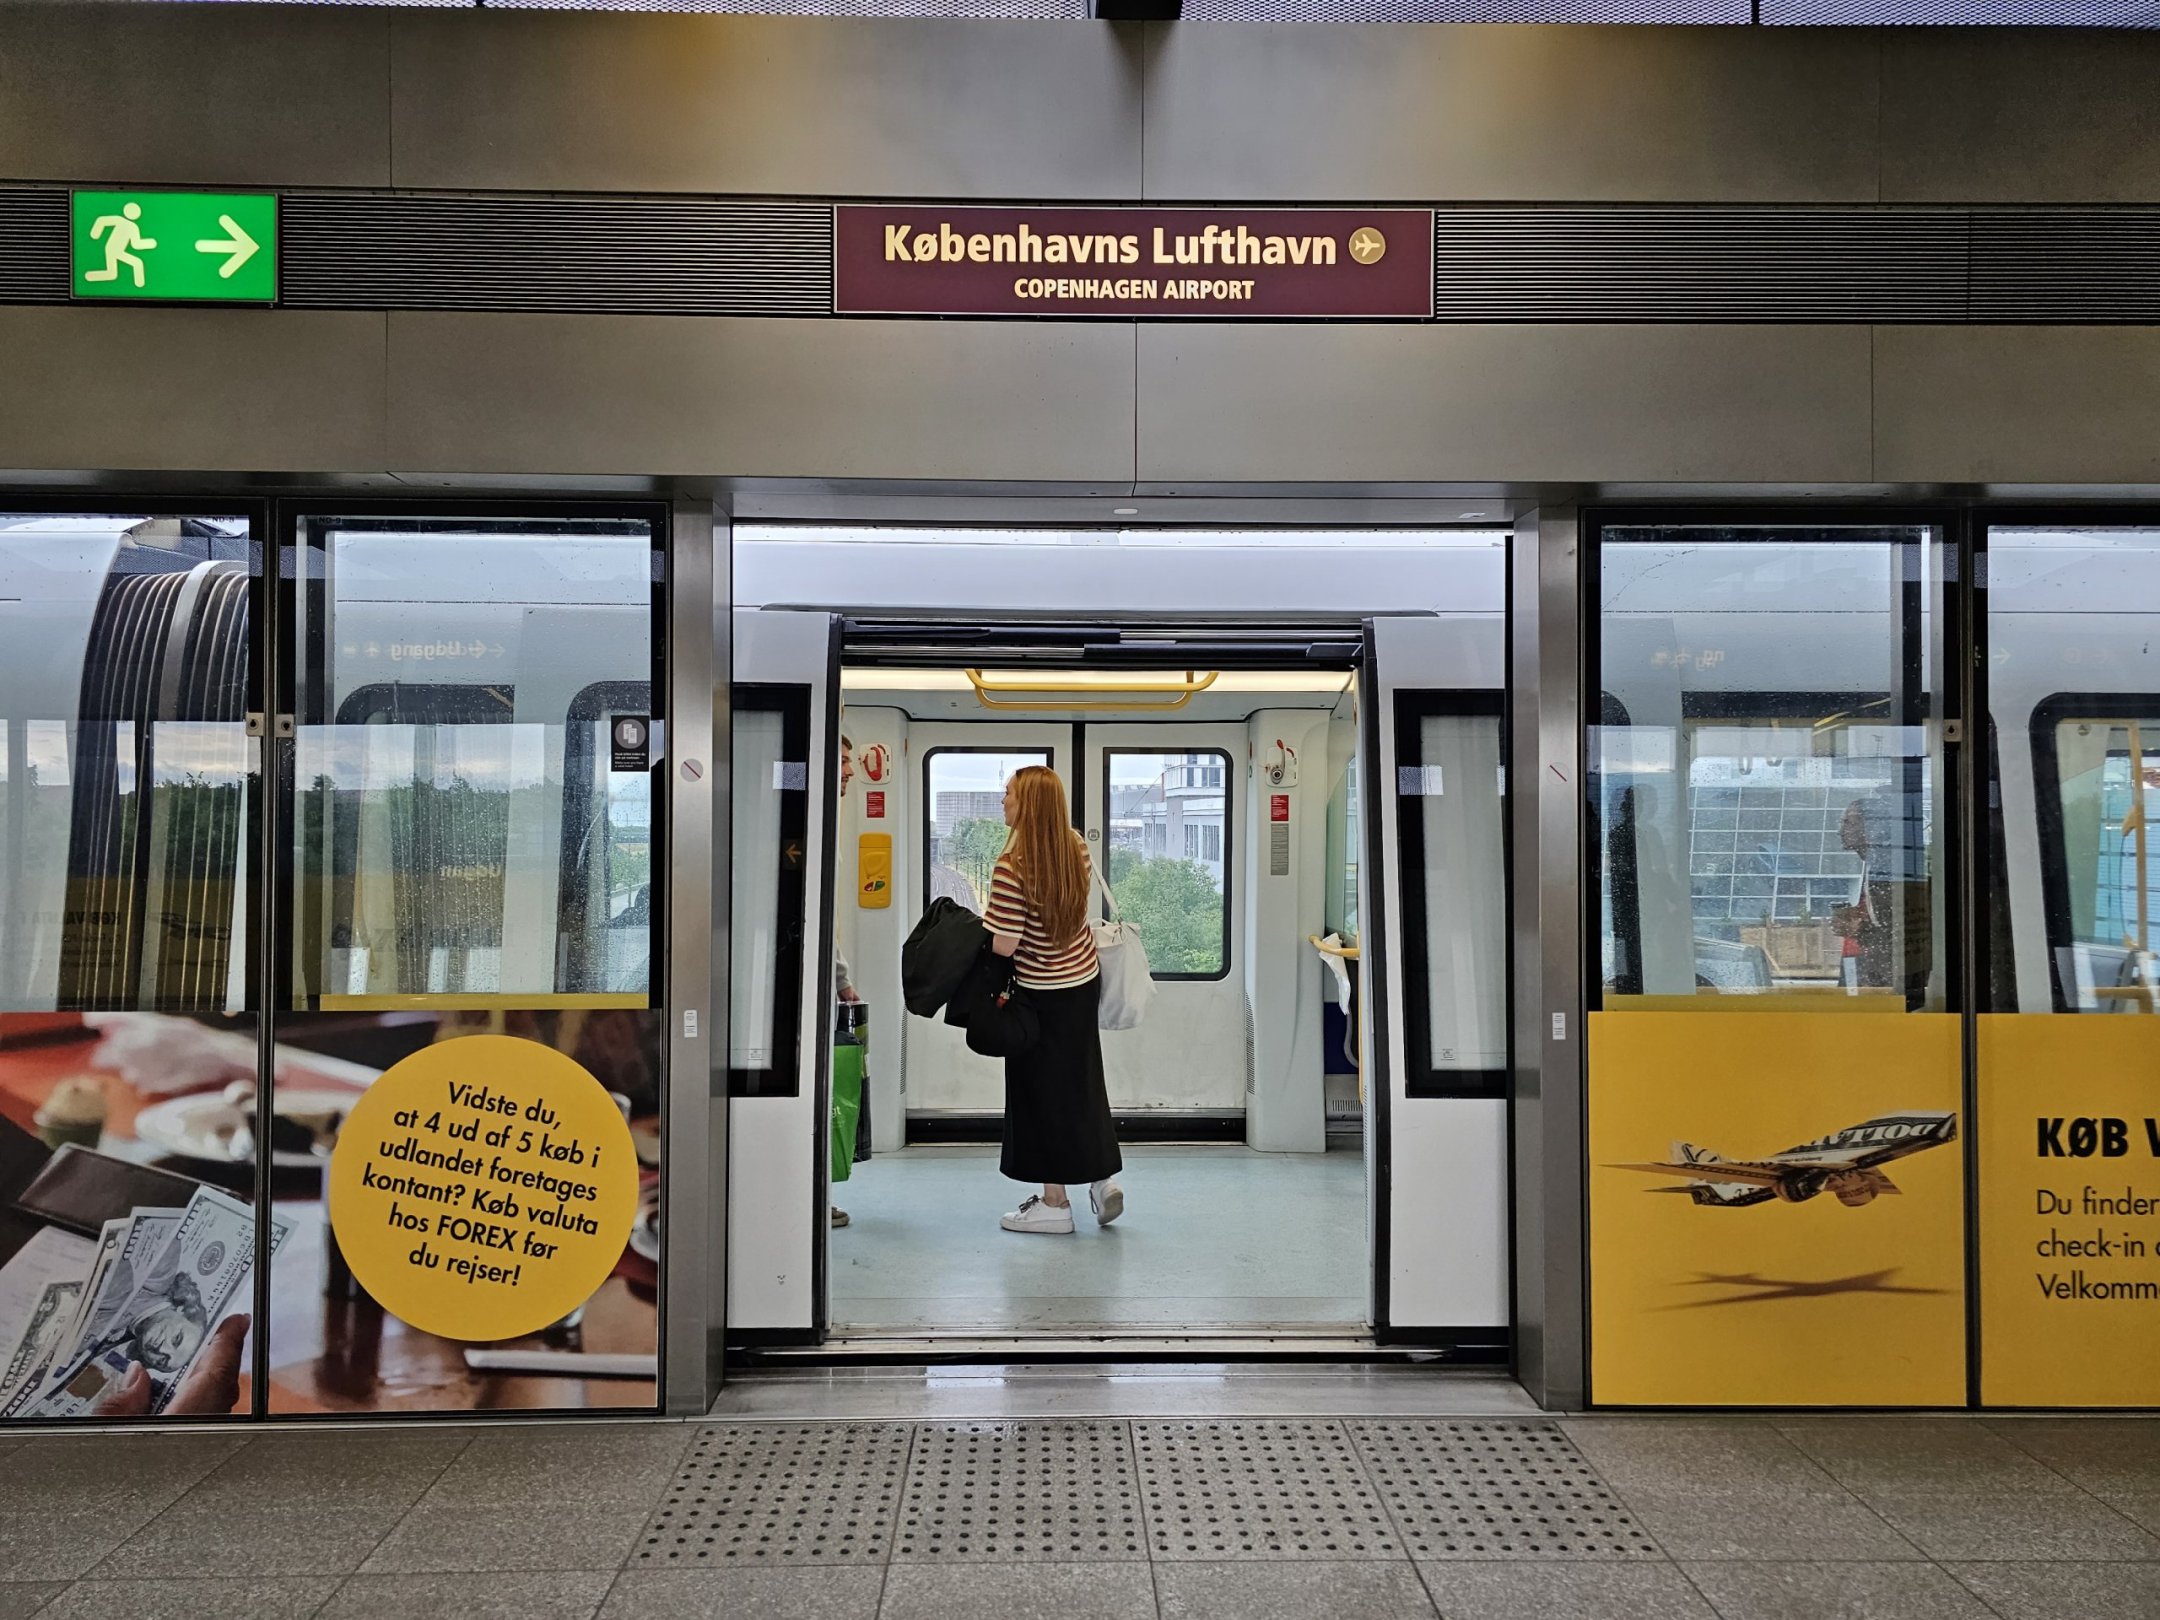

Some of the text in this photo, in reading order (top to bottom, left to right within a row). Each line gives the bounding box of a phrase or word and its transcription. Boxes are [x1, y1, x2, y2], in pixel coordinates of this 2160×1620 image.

[884, 223, 1337, 264] Københavns Lufthavn
[1014, 278, 1255, 300] COPENHAGEN AIRPORT
[449, 1082, 561, 1130] Vidste du,
[393, 1109, 601, 1168] at 4 ud af 5 køb i
[2036, 1117, 2129, 1158] KØB
[379, 1137, 597, 1201] udlandet foretages
[362, 1163, 599, 1235] kontant? Køb valuta
[2037, 1185, 2160, 1215] Du finder
[388, 1202, 558, 1260] hos FOREX før
[2036, 1227, 2145, 1257] check-in
[408, 1242, 521, 1286] du rejser!
[2036, 1270, 2160, 1299] Velkomm
